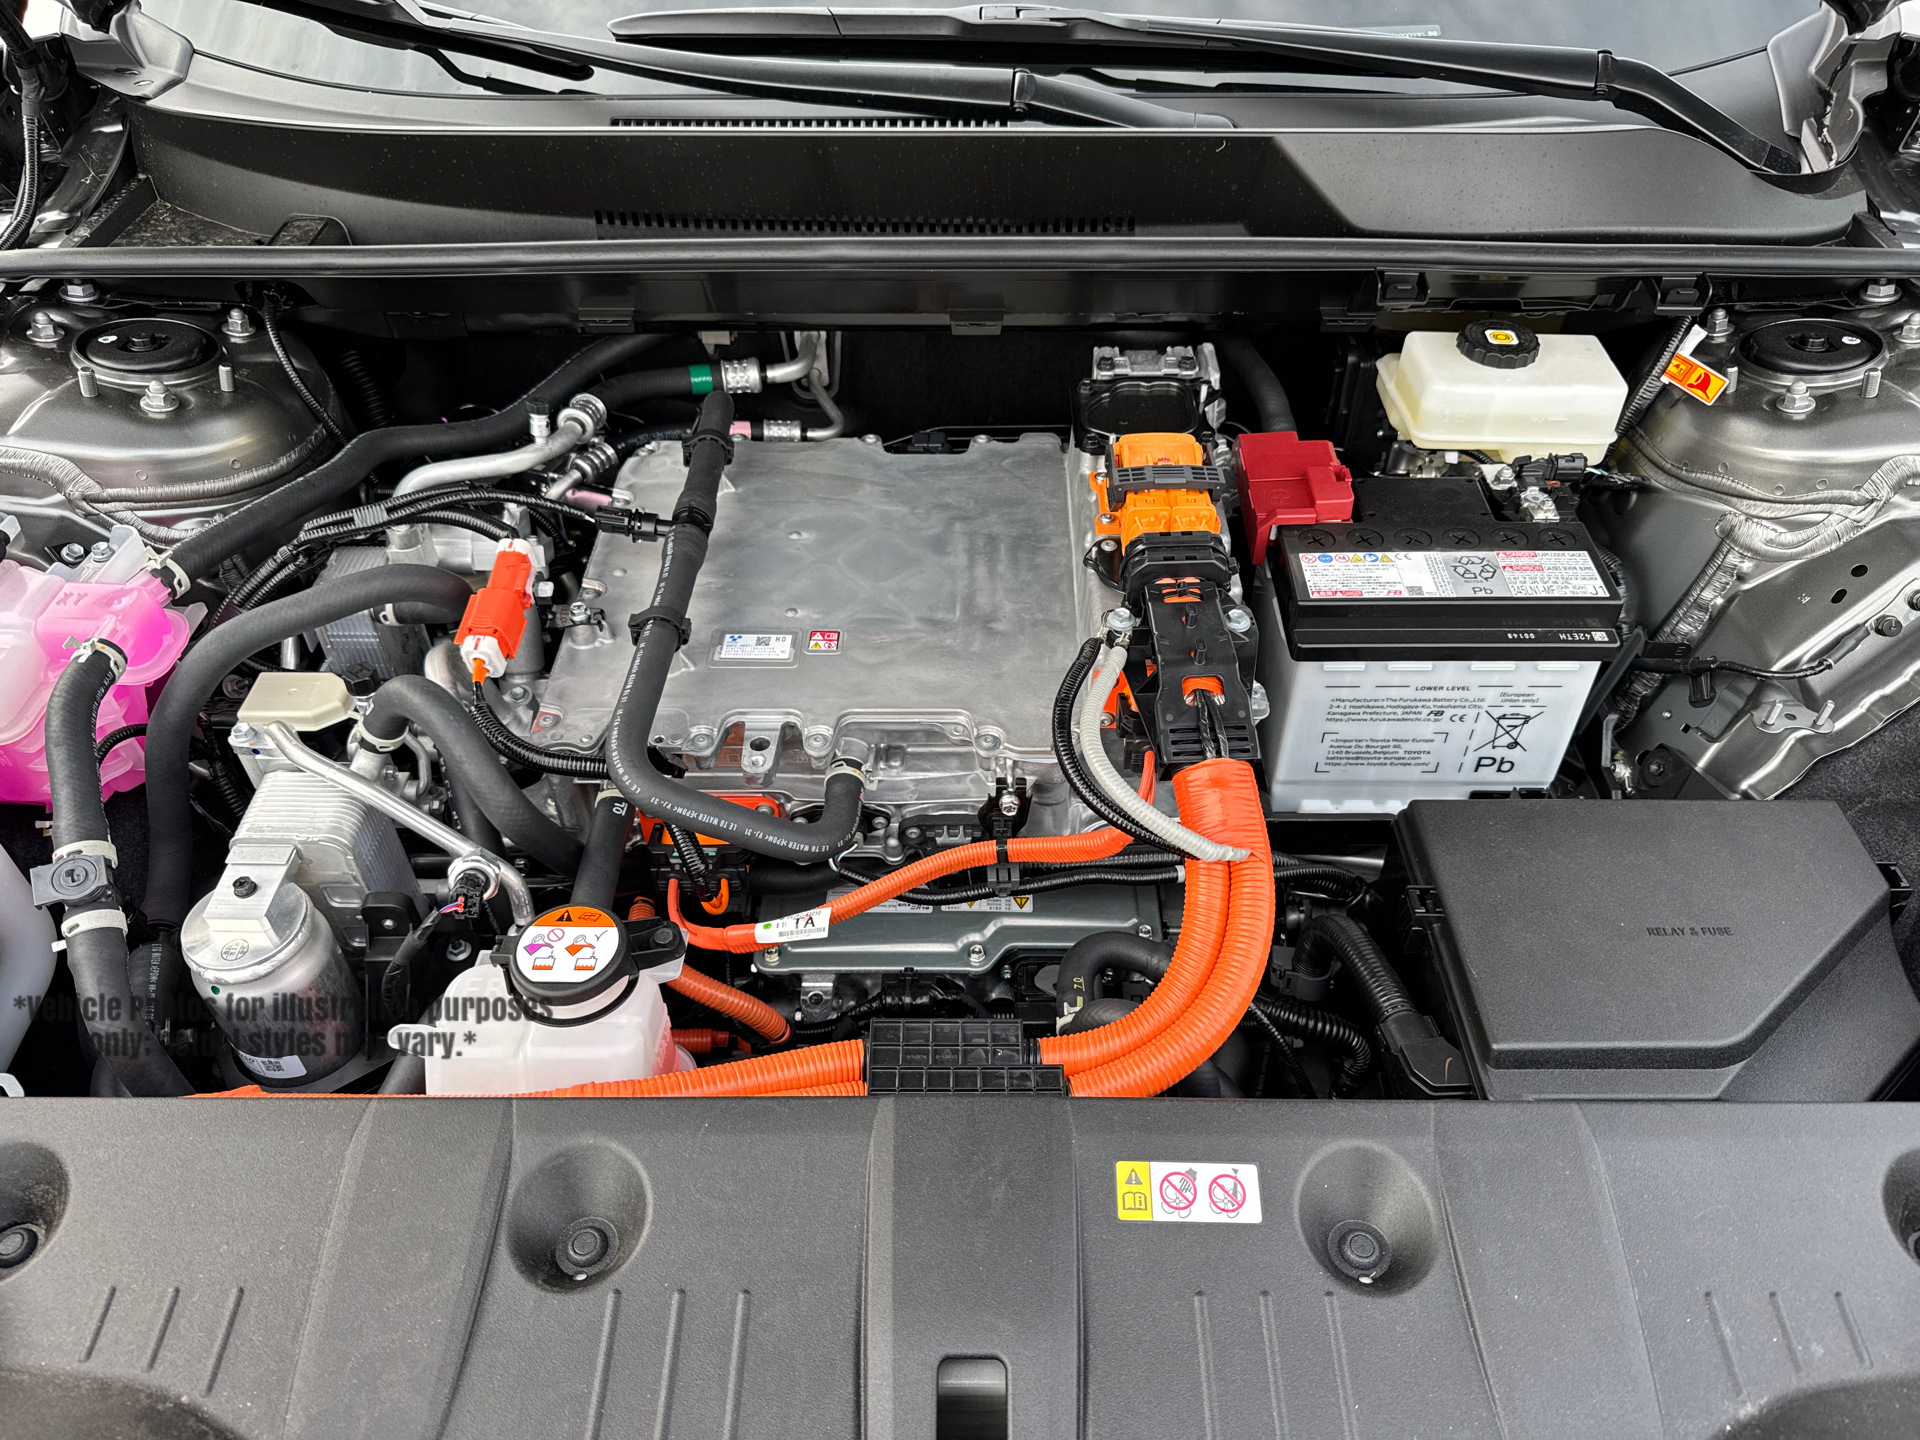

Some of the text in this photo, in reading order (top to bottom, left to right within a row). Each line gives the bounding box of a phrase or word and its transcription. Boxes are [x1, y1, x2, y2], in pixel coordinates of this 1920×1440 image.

[1472, 587, 1493, 595] Pb
[1559, 633, 1591, 641] 42ETH
[612, 752, 624, 775] WATER
[1473, 757, 1515, 773] Pb
[698, 813, 719, 826] WATER
[728, 823, 738, 831] LE
[788, 841, 809, 852] WATER
[793, 915, 815, 929] TA
[1646, 927, 1734, 936] RELAY & FUSE
